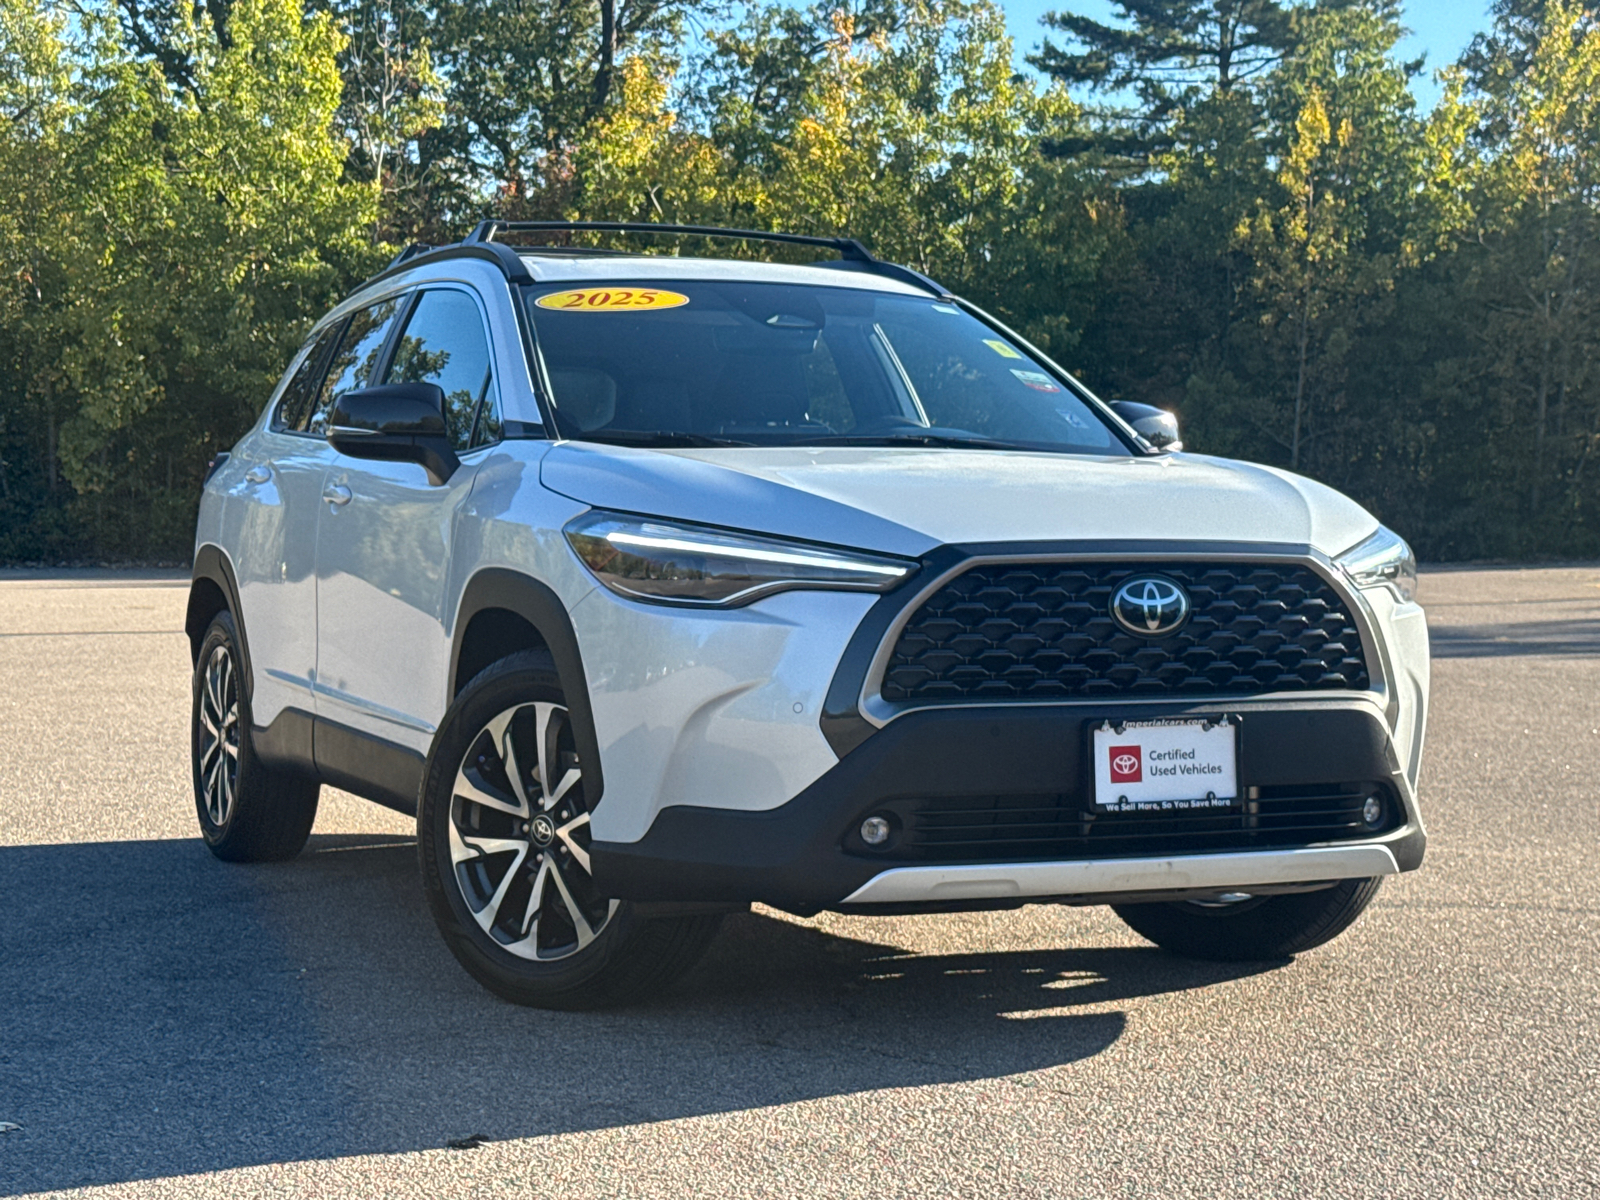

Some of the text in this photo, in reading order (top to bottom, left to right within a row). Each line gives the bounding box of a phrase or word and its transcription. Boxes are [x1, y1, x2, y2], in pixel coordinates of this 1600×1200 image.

[562, 292, 658, 308] 2025
[1149, 748, 1195, 761] Certified
[1150, 764, 1222, 776] Used Vehicles
[1106, 799, 1231, 812] We Sell More, So You Save More
